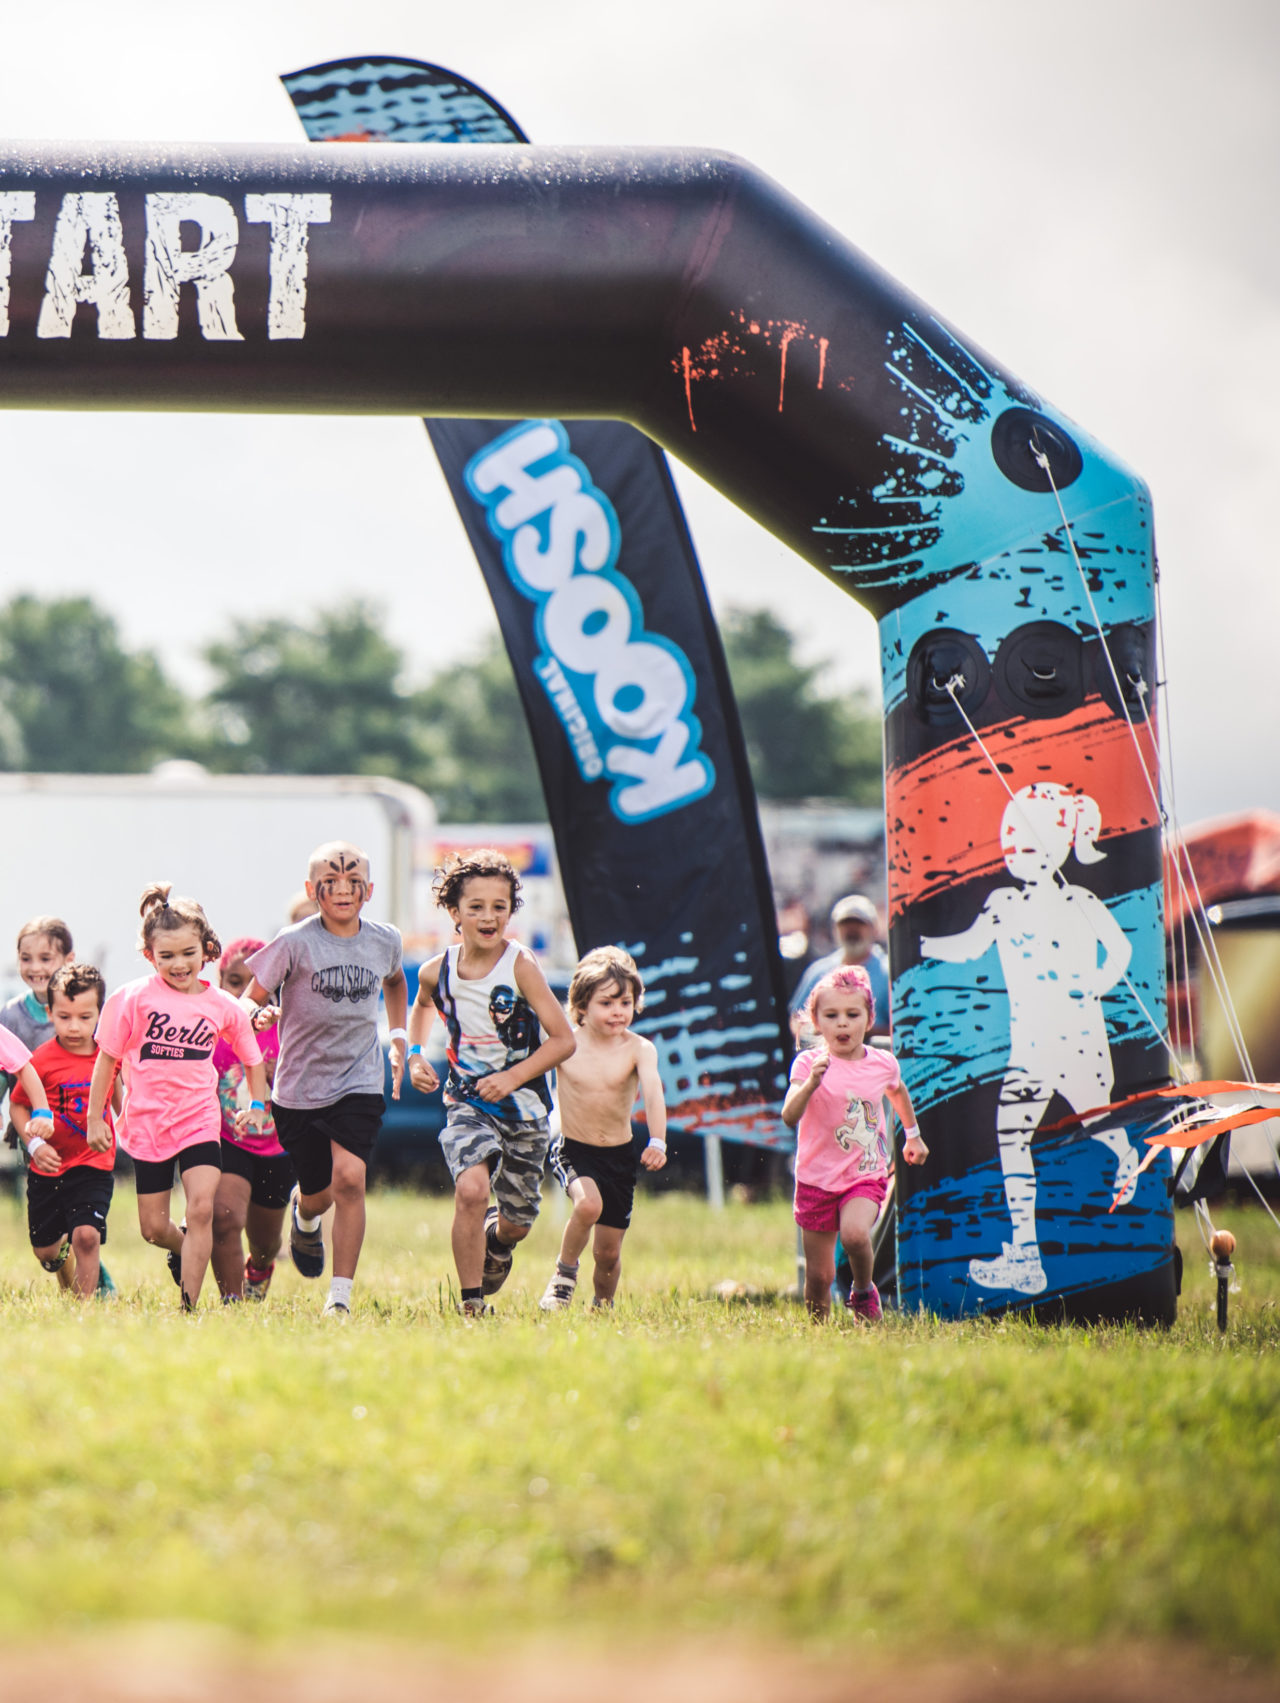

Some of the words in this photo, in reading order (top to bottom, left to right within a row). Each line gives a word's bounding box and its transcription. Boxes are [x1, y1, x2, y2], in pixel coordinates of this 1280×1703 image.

[471, 424, 708, 817] KOOSH
[540, 656, 603, 778] ORIGINAL
[311, 964, 380, 997] GETTYSBURG
[145, 1011, 215, 1047] Berlin
[151, 1044, 185, 1058] SOFTIES
